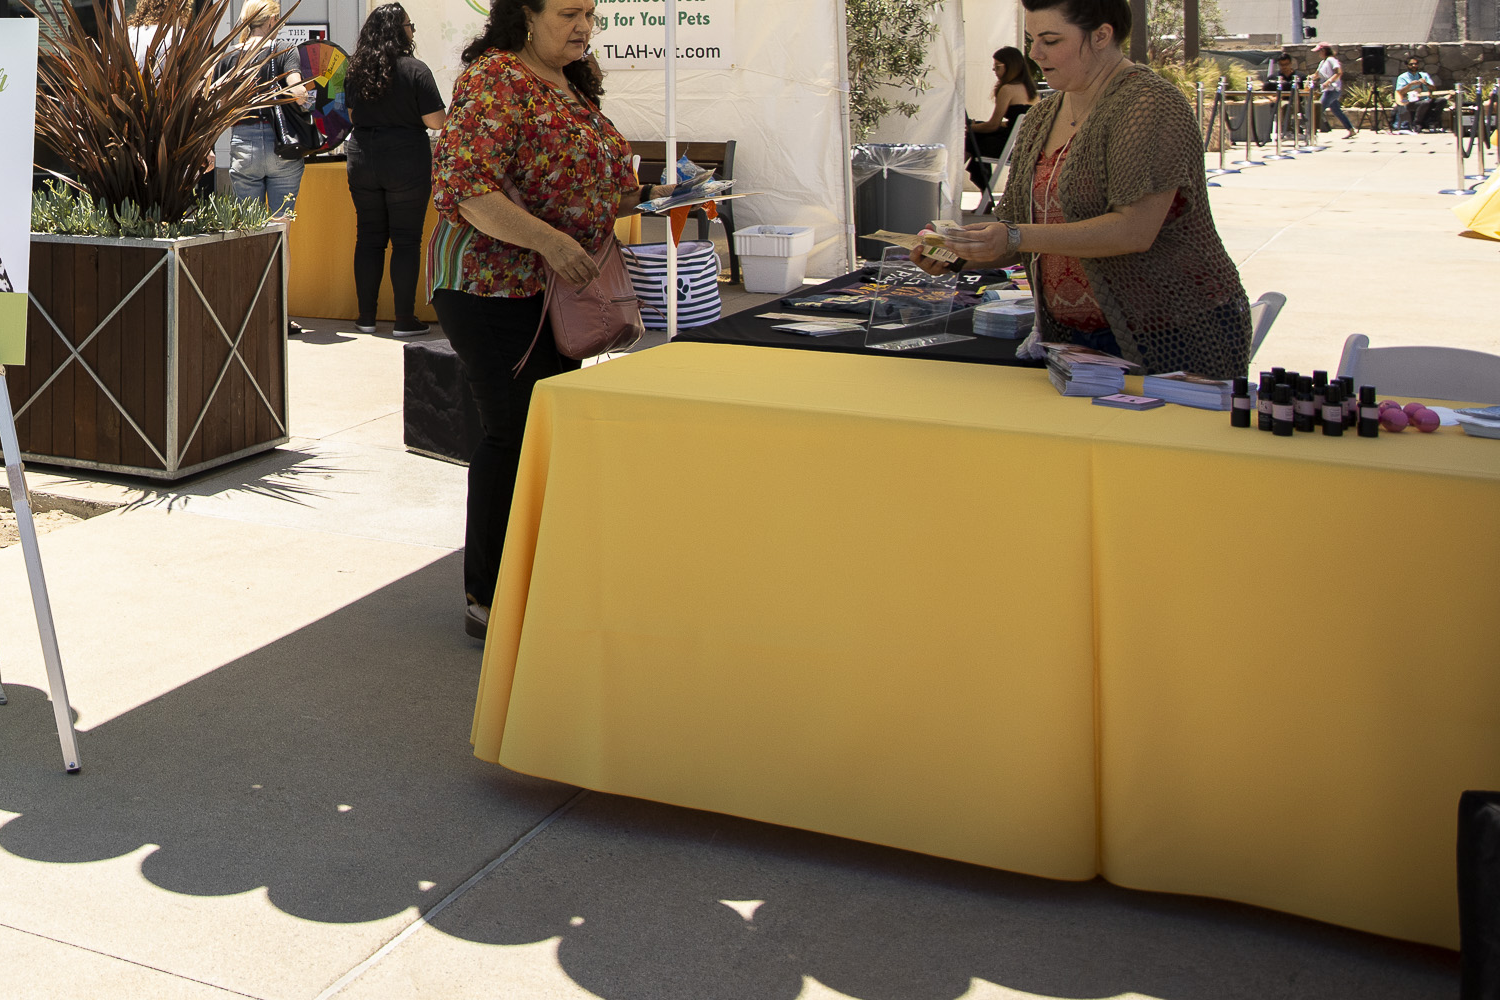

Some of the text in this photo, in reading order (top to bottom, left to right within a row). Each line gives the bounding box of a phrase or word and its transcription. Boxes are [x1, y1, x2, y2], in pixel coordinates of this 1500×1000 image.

[613, 11, 635, 27] for
[639, 11, 666, 27] You
[678, 11, 711, 26] Pets
[603, 44, 722, 59] TLAH-vt.com
